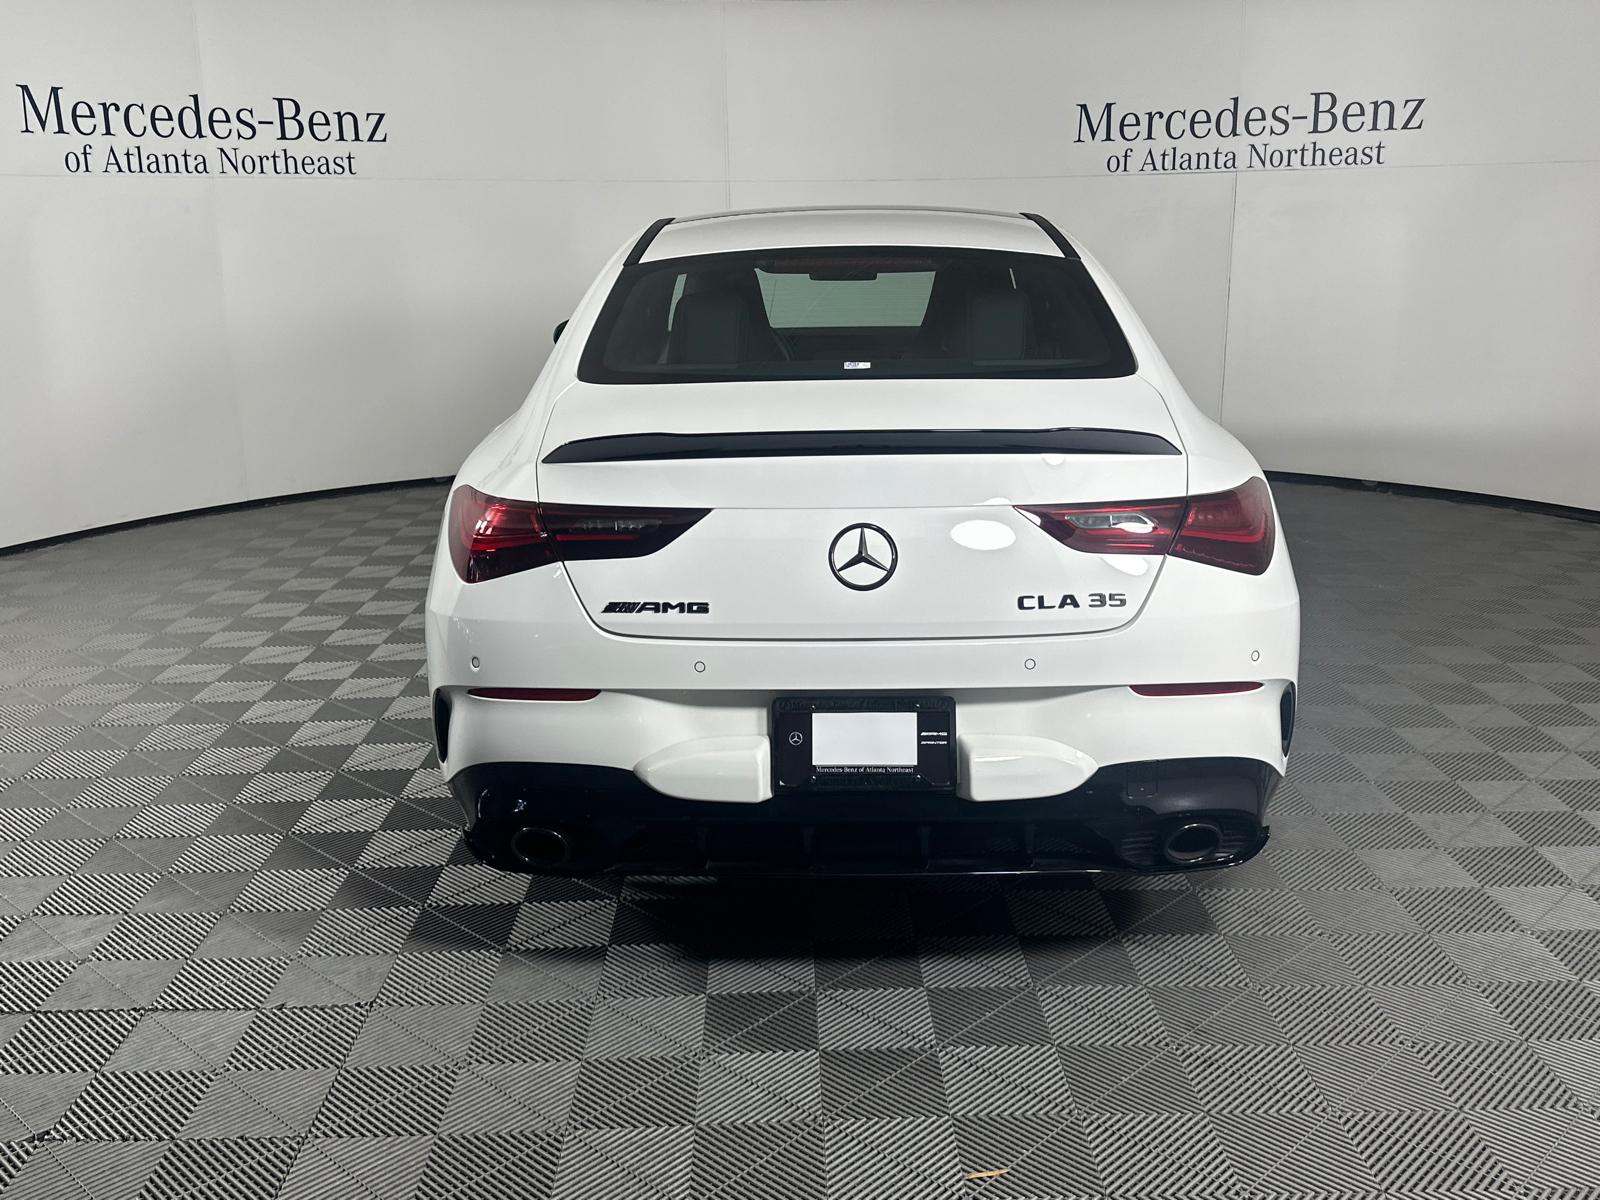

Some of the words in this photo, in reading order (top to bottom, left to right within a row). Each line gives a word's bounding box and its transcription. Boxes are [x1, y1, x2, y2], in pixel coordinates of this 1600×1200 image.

[15, 83, 388, 142] Mercedes-Benz
[1073, 91, 1426, 143] Mercedes-Benz
[64, 144, 92, 174] of
[103, 145, 210, 175] Atlanta
[217, 147, 357, 175] Northeast
[1106, 148, 1133, 173] of
[1138, 146, 1238, 172] Atlanta
[1247, 141, 1386, 169] Northeast
[1017, 594, 1081, 610] CLA
[1088, 592, 1127, 608] 35
